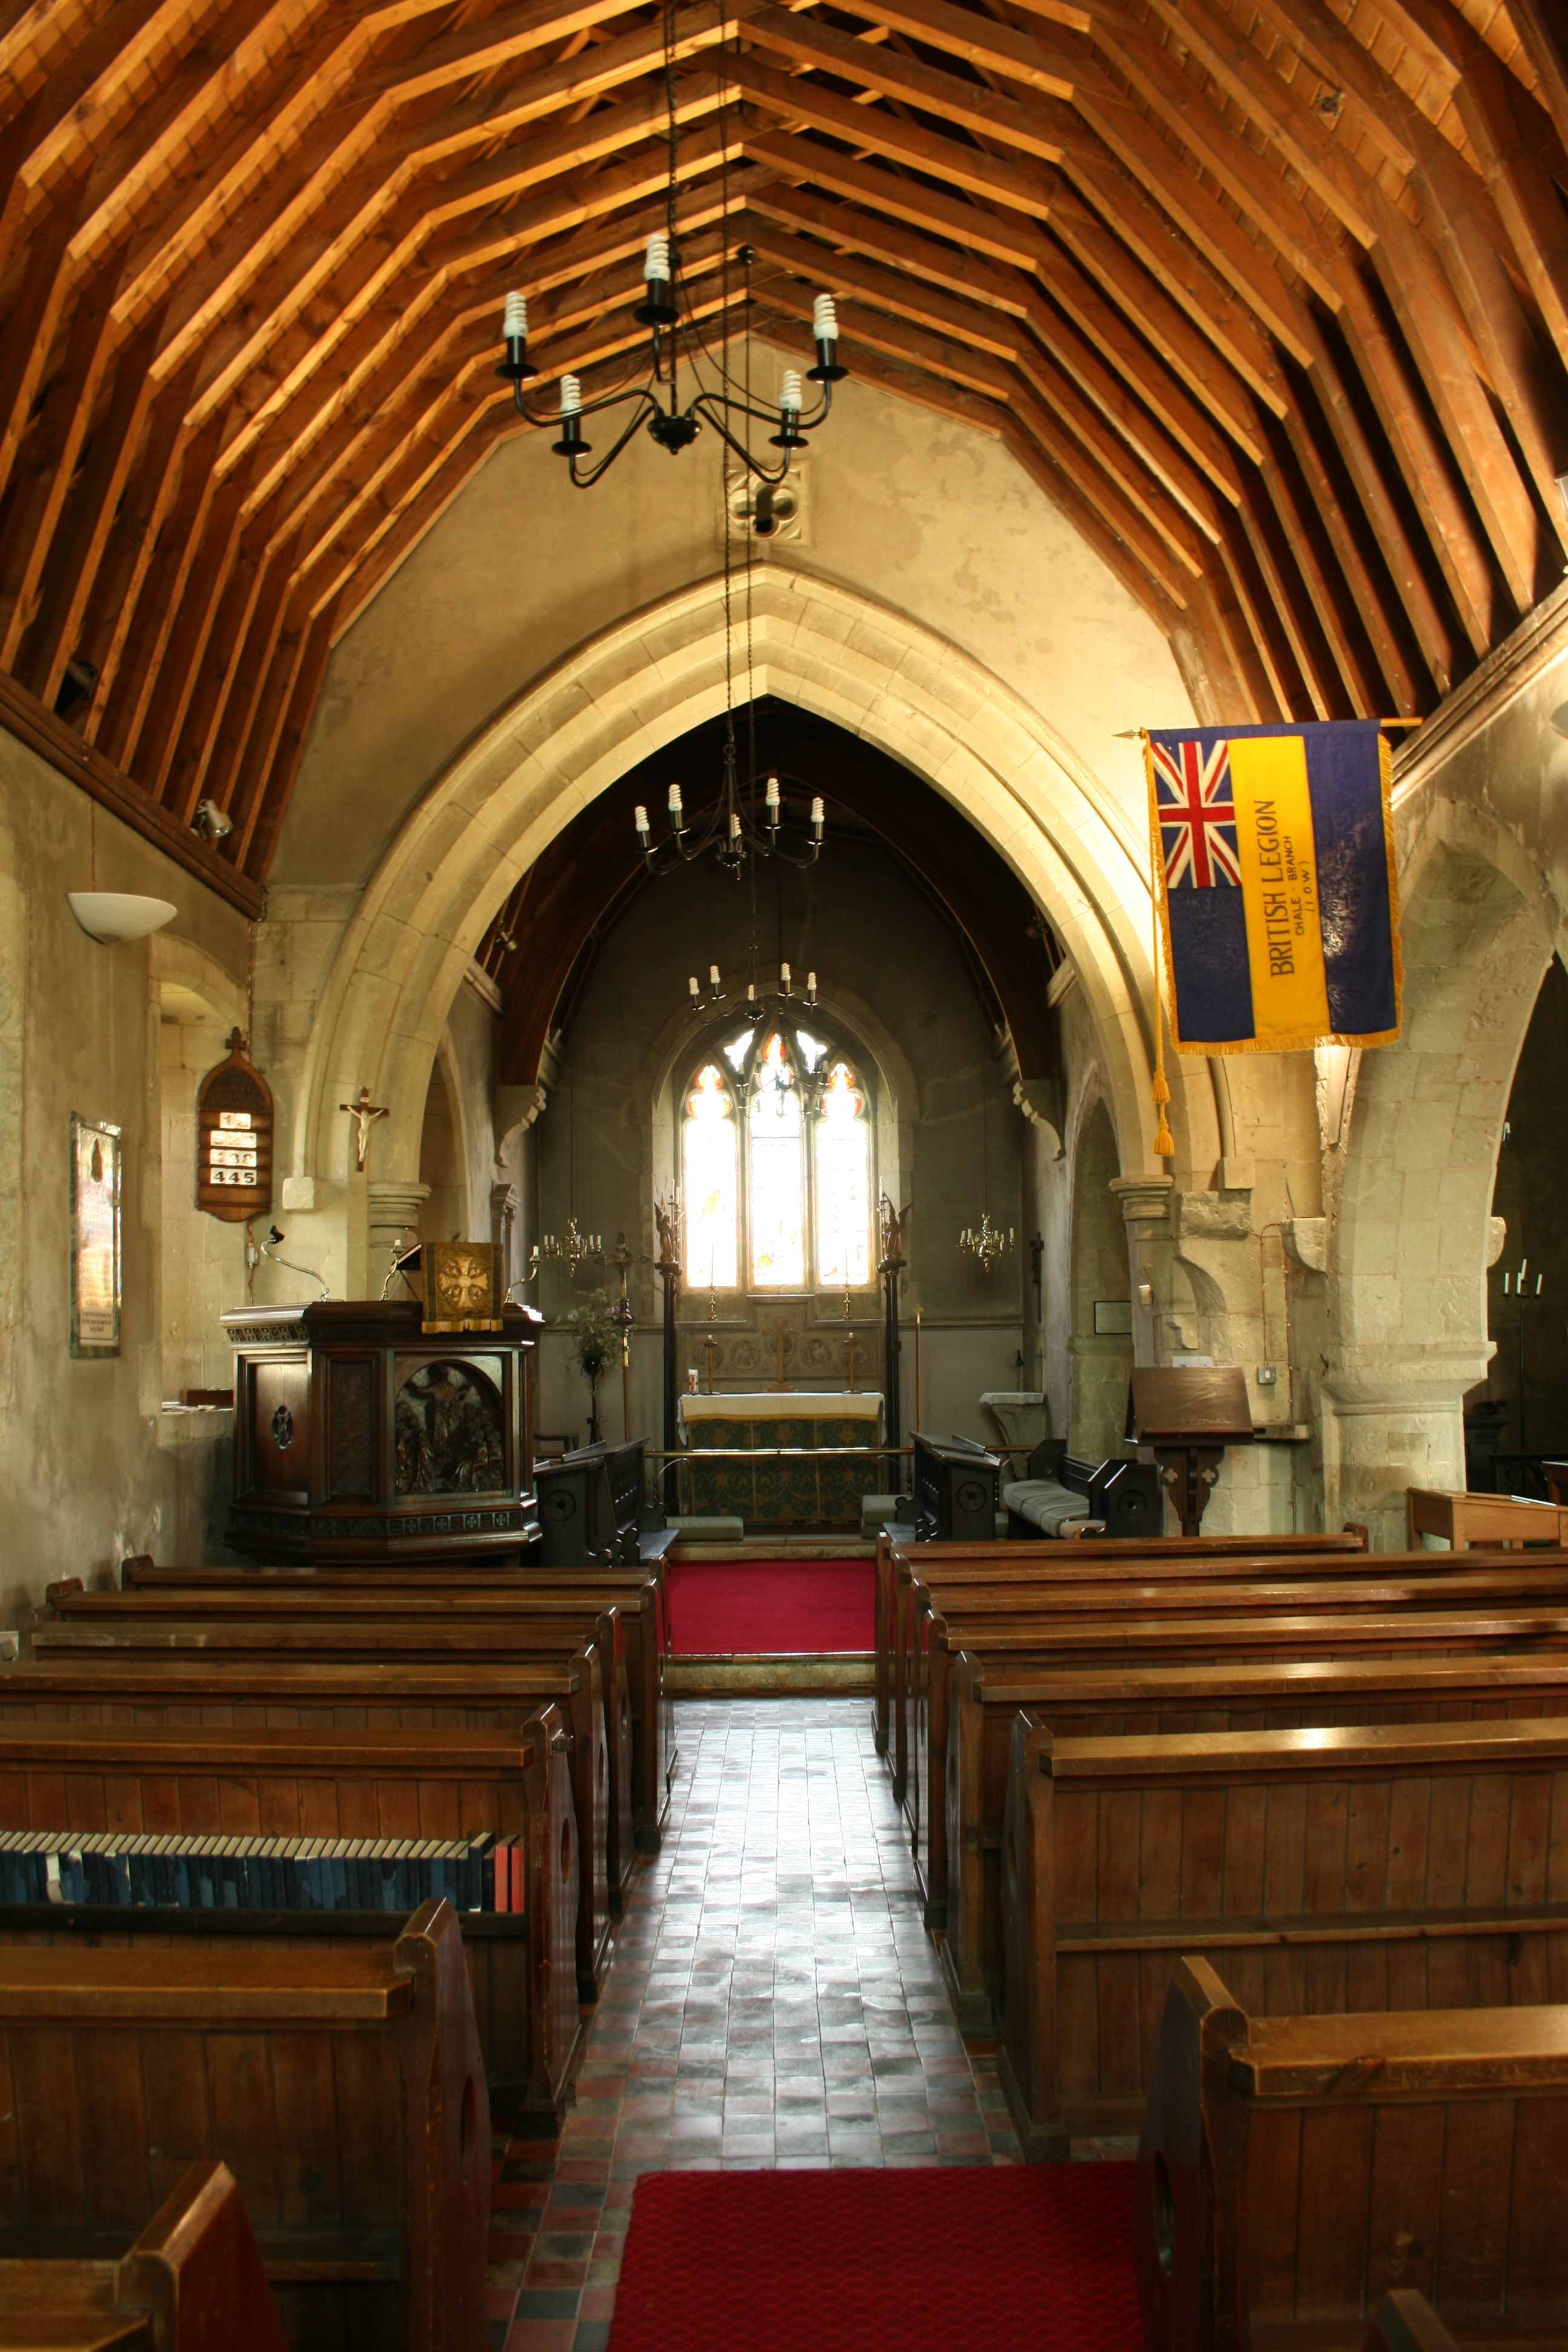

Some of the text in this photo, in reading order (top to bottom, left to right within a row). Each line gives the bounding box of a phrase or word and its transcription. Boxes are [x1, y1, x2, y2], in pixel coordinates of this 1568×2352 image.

[1283, 836, 1297, 880] BRANCH
[1253, 800, 1295, 978] BRITISH LEGION
[1291, 897, 1305, 936] CHALE
[214, 1171, 254, 1184] 445
